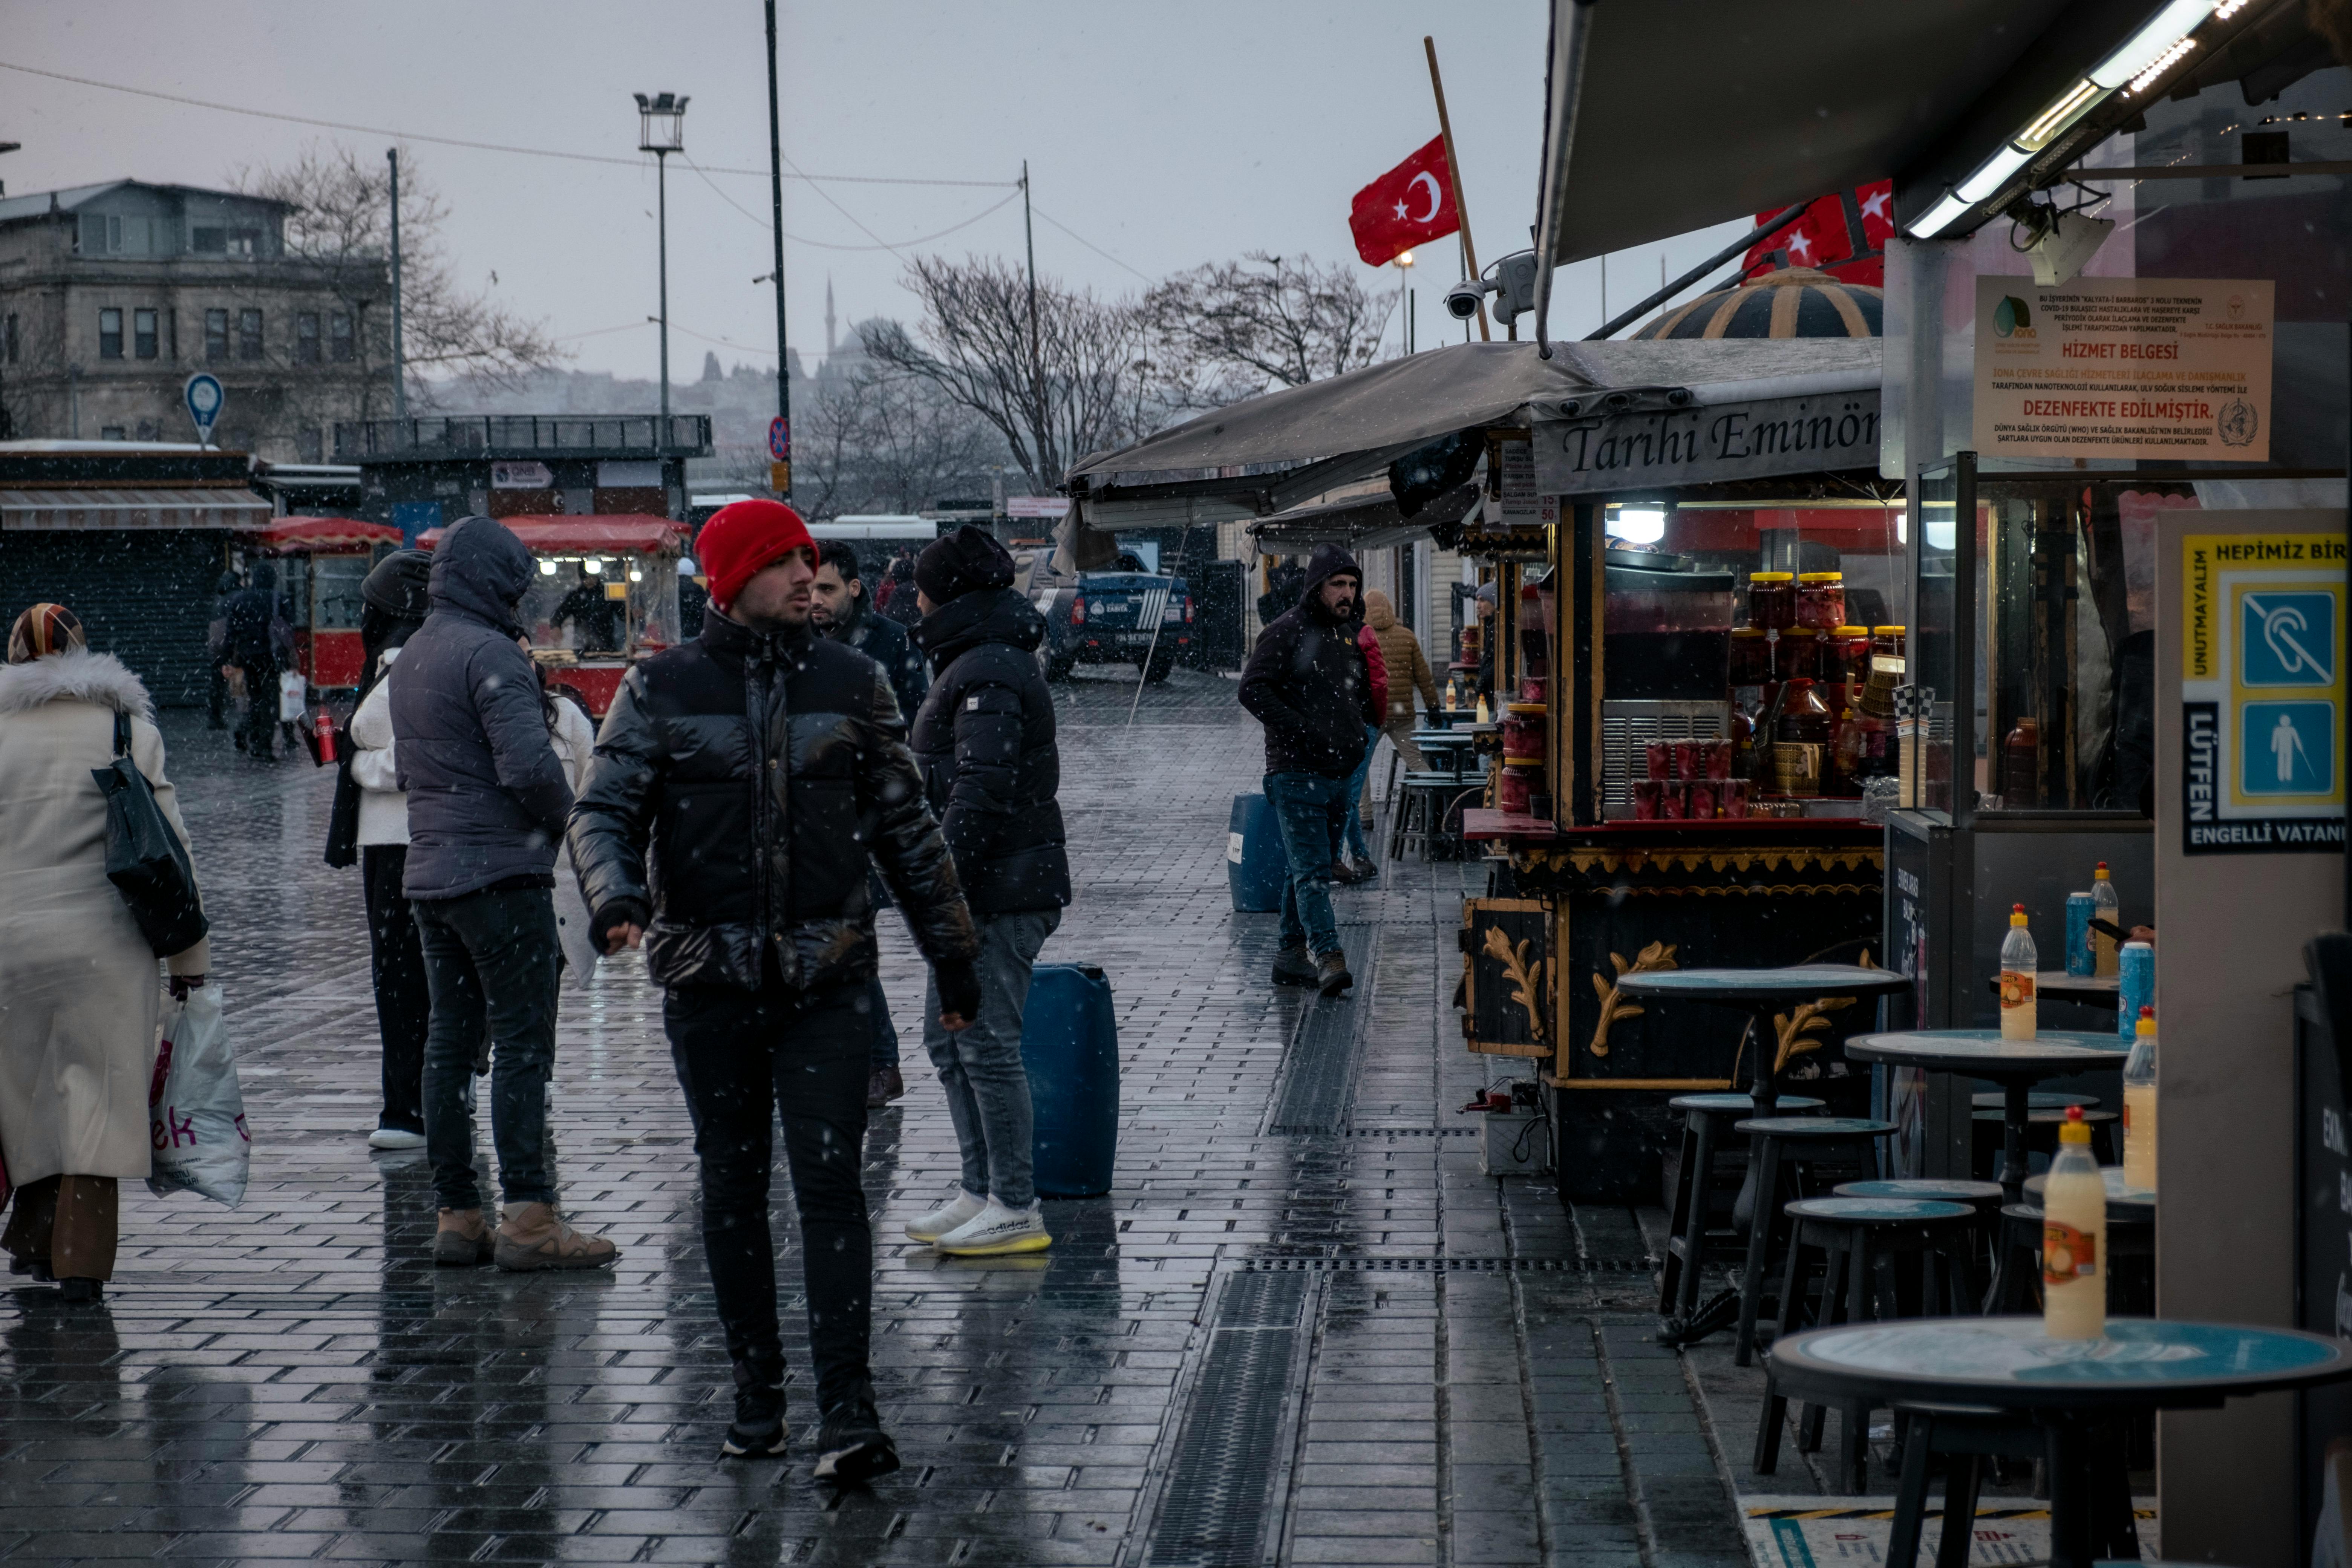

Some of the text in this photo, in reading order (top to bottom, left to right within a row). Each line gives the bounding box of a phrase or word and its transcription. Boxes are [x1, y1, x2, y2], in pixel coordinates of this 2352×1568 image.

[2063, 323, 2082, 332] İŞLEMİ
[2063, 339, 2179, 360] HİZMET BELGESİ
[2081, 368, 2130, 380] HİZMETLERİ
[2176, 372, 2186, 381] VE
[2035, 381, 2087, 391] NANOTEKNOLOJİ
[2155, 383, 2176, 393] SOĞUK
[2178, 384, 2205, 394] SİSLEME
[2207, 384, 2235, 394] YÖNTEMİ
[2237, 386, 2247, 394] İLE
[2024, 398, 2214, 422] DEZENFEKTE EDİLMİŞTİR.
[1562, 402, 1882, 473] Tarihi Eminön
[1994, 424, 2016, 433] DÜNYA
[2018, 424, 2040, 433] SAĞLIK
[2042, 424, 2067, 433] ÖRGÜTÜ
[2069, 426, 2089, 435] (WHO)
[2100, 425, 2122, 434] SAĞLIK
[2173, 426, 2212, 436] BELİRLEDİĞİ
[1998, 435, 2029, 444] ŞARTLARA
[2072, 436, 2110, 444] DEZENFEKTE
[2112, 435, 2143, 445] ÜRÜNLERİ
[2145, 437, 2208, 446] KULLANILMAKTADIR.
[2216, 540, 2304, 560] HEPİMİZ
[2193, 550, 2208, 676] UNUTMAYALIM
[2188, 712, 2217, 821] LÜTFEN
[2190, 822, 2345, 844] ENGELLİ VATAN
[987, 1220, 1030, 1234] adidas
